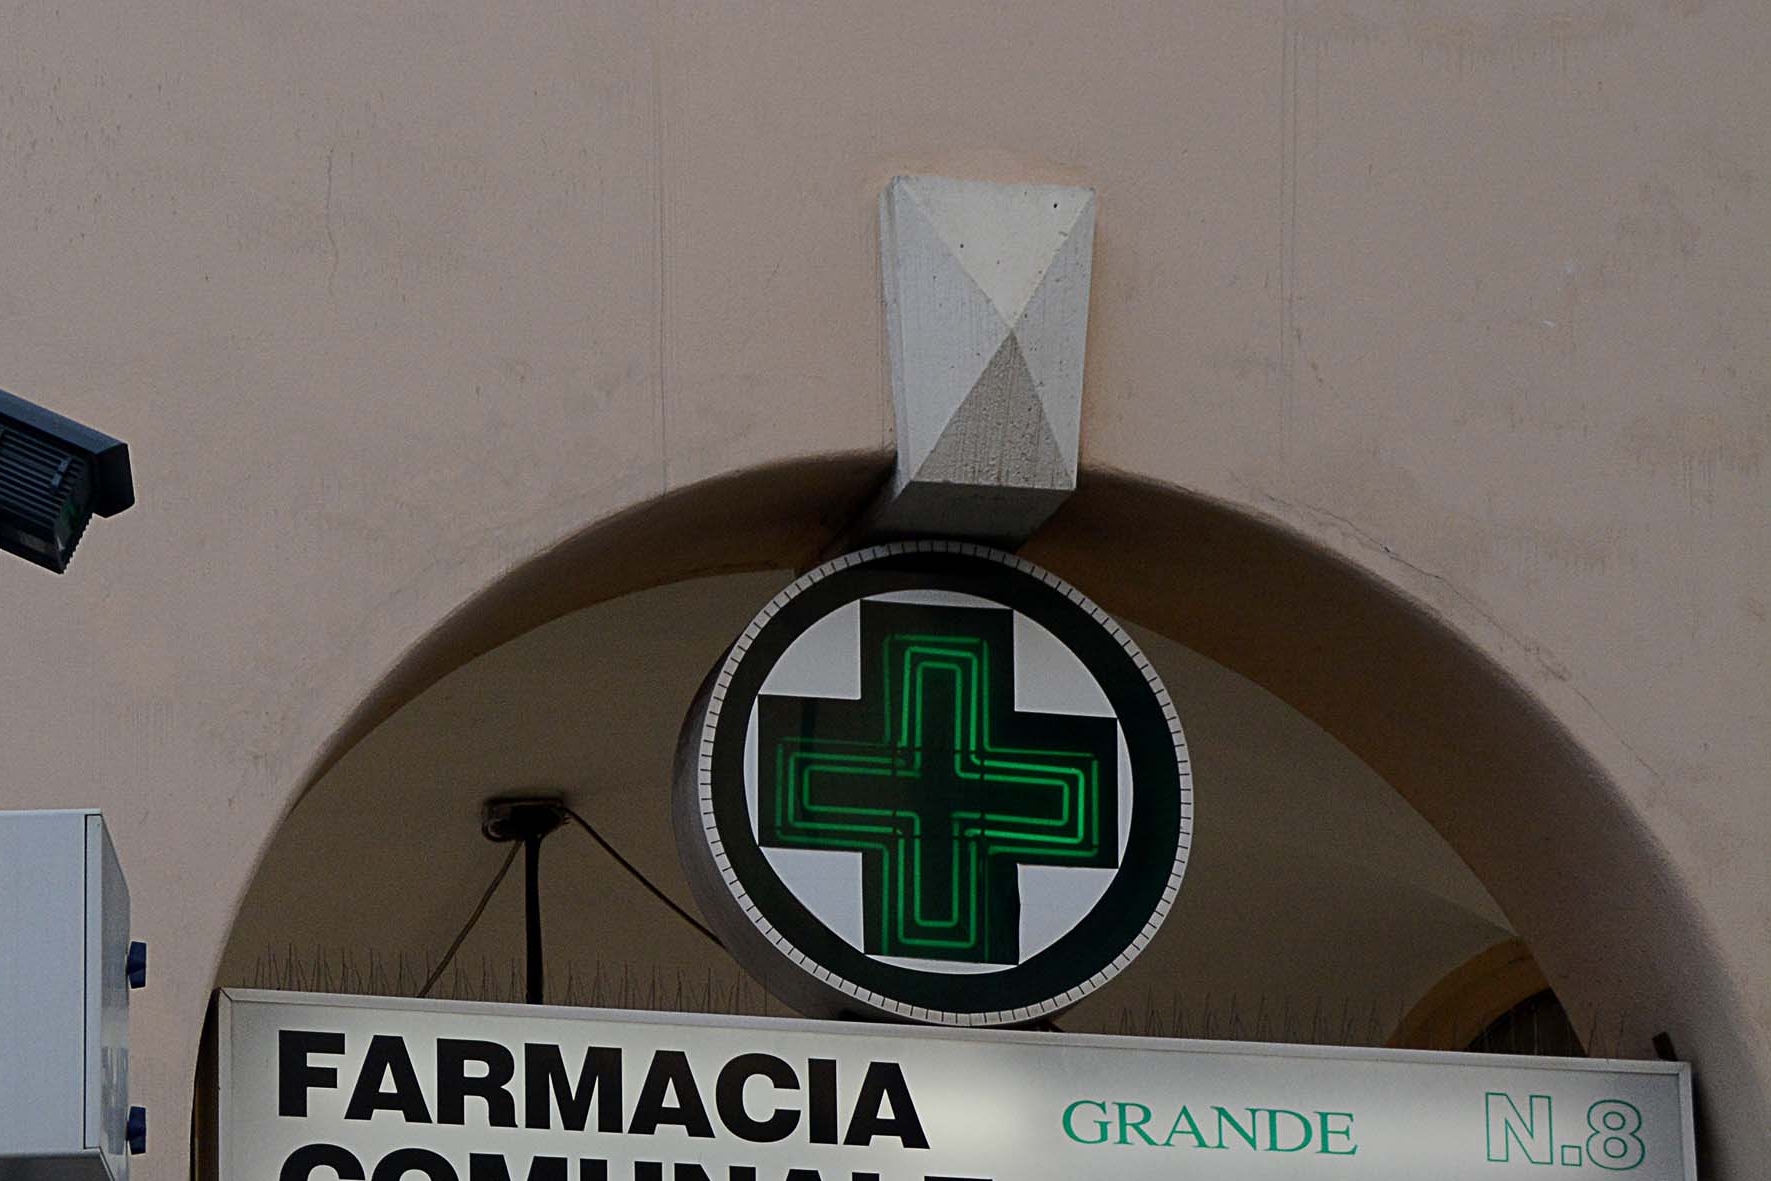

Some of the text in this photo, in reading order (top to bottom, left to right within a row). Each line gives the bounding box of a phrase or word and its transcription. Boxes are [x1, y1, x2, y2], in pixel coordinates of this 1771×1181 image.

[277, 1029, 930, 1150] FARMACIA
[1061, 1100, 1359, 1156] GRANDE
[1484, 1092, 1646, 1171] N.8
